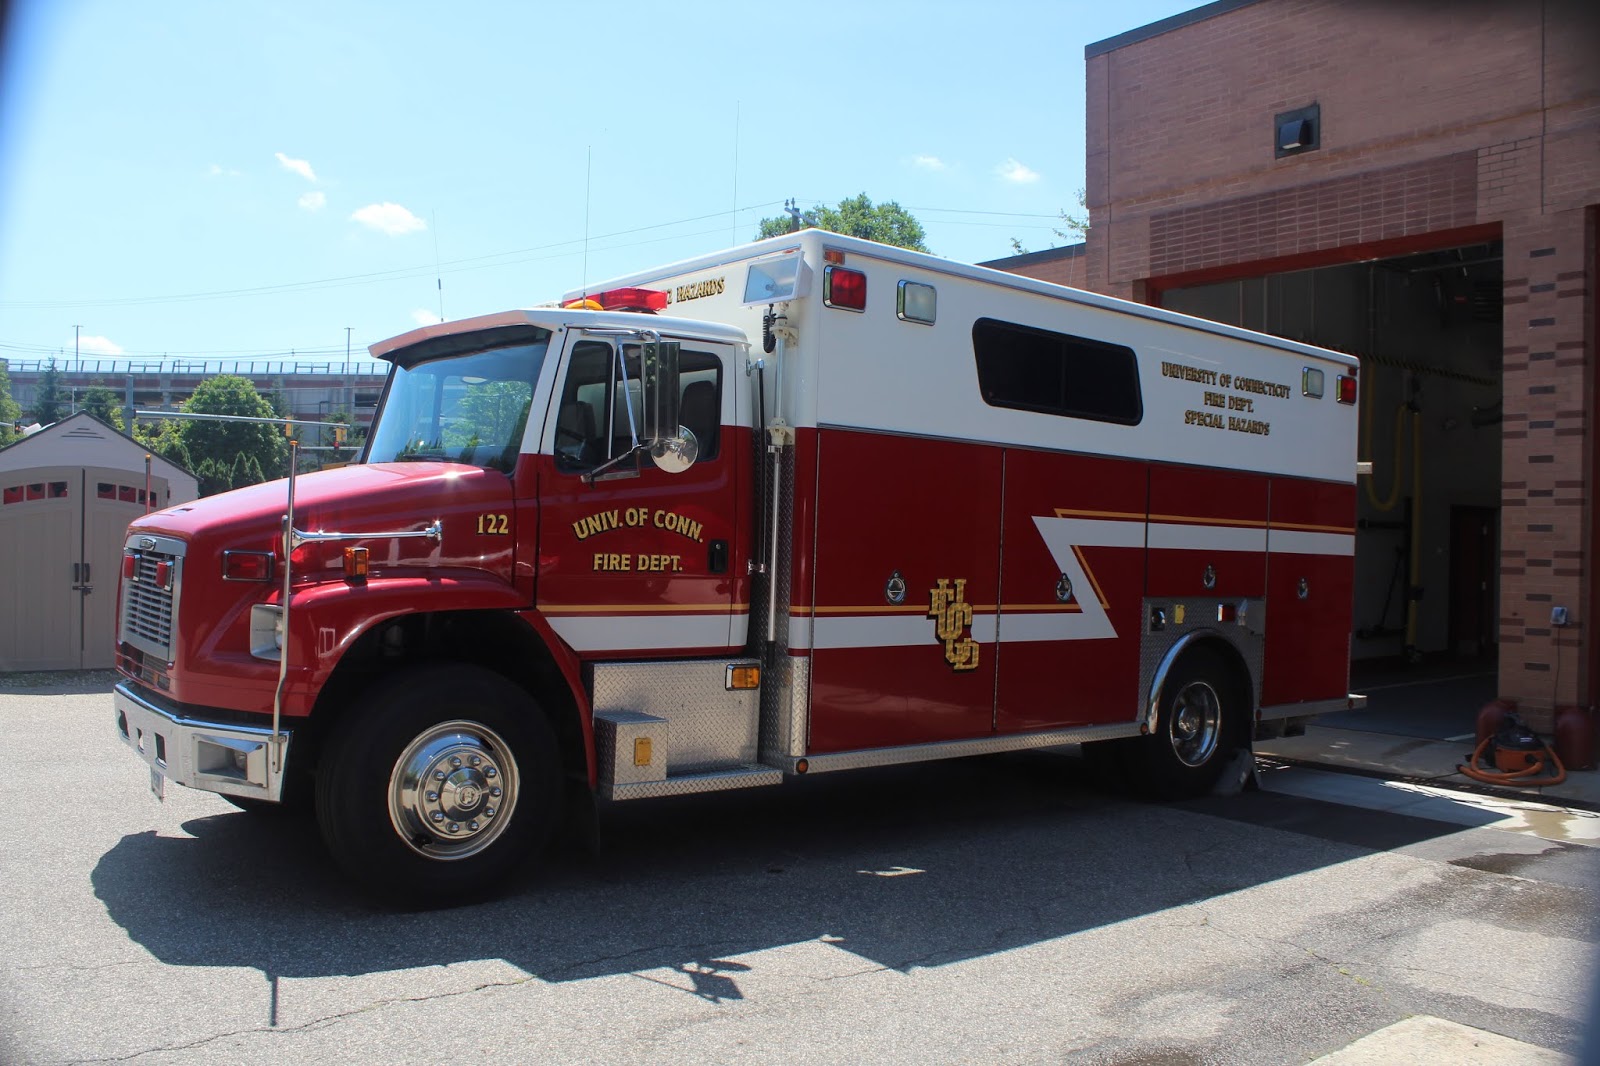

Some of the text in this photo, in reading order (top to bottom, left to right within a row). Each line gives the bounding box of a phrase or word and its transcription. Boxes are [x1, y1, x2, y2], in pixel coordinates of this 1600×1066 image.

[676, 277, 725, 303] HAZARDS
[1161, 361, 1291, 399] UNIVERSITY OF CONNECTICUT
[1204, 391, 1254, 413] FIRE DEPT.
[1184, 409, 1270, 436] SPECIAL HAZARDS
[476, 513, 509, 535] 122
[572, 507, 704, 543] UNIV. OF CONN.
[593, 553, 683, 572] FIRE DEPT.
